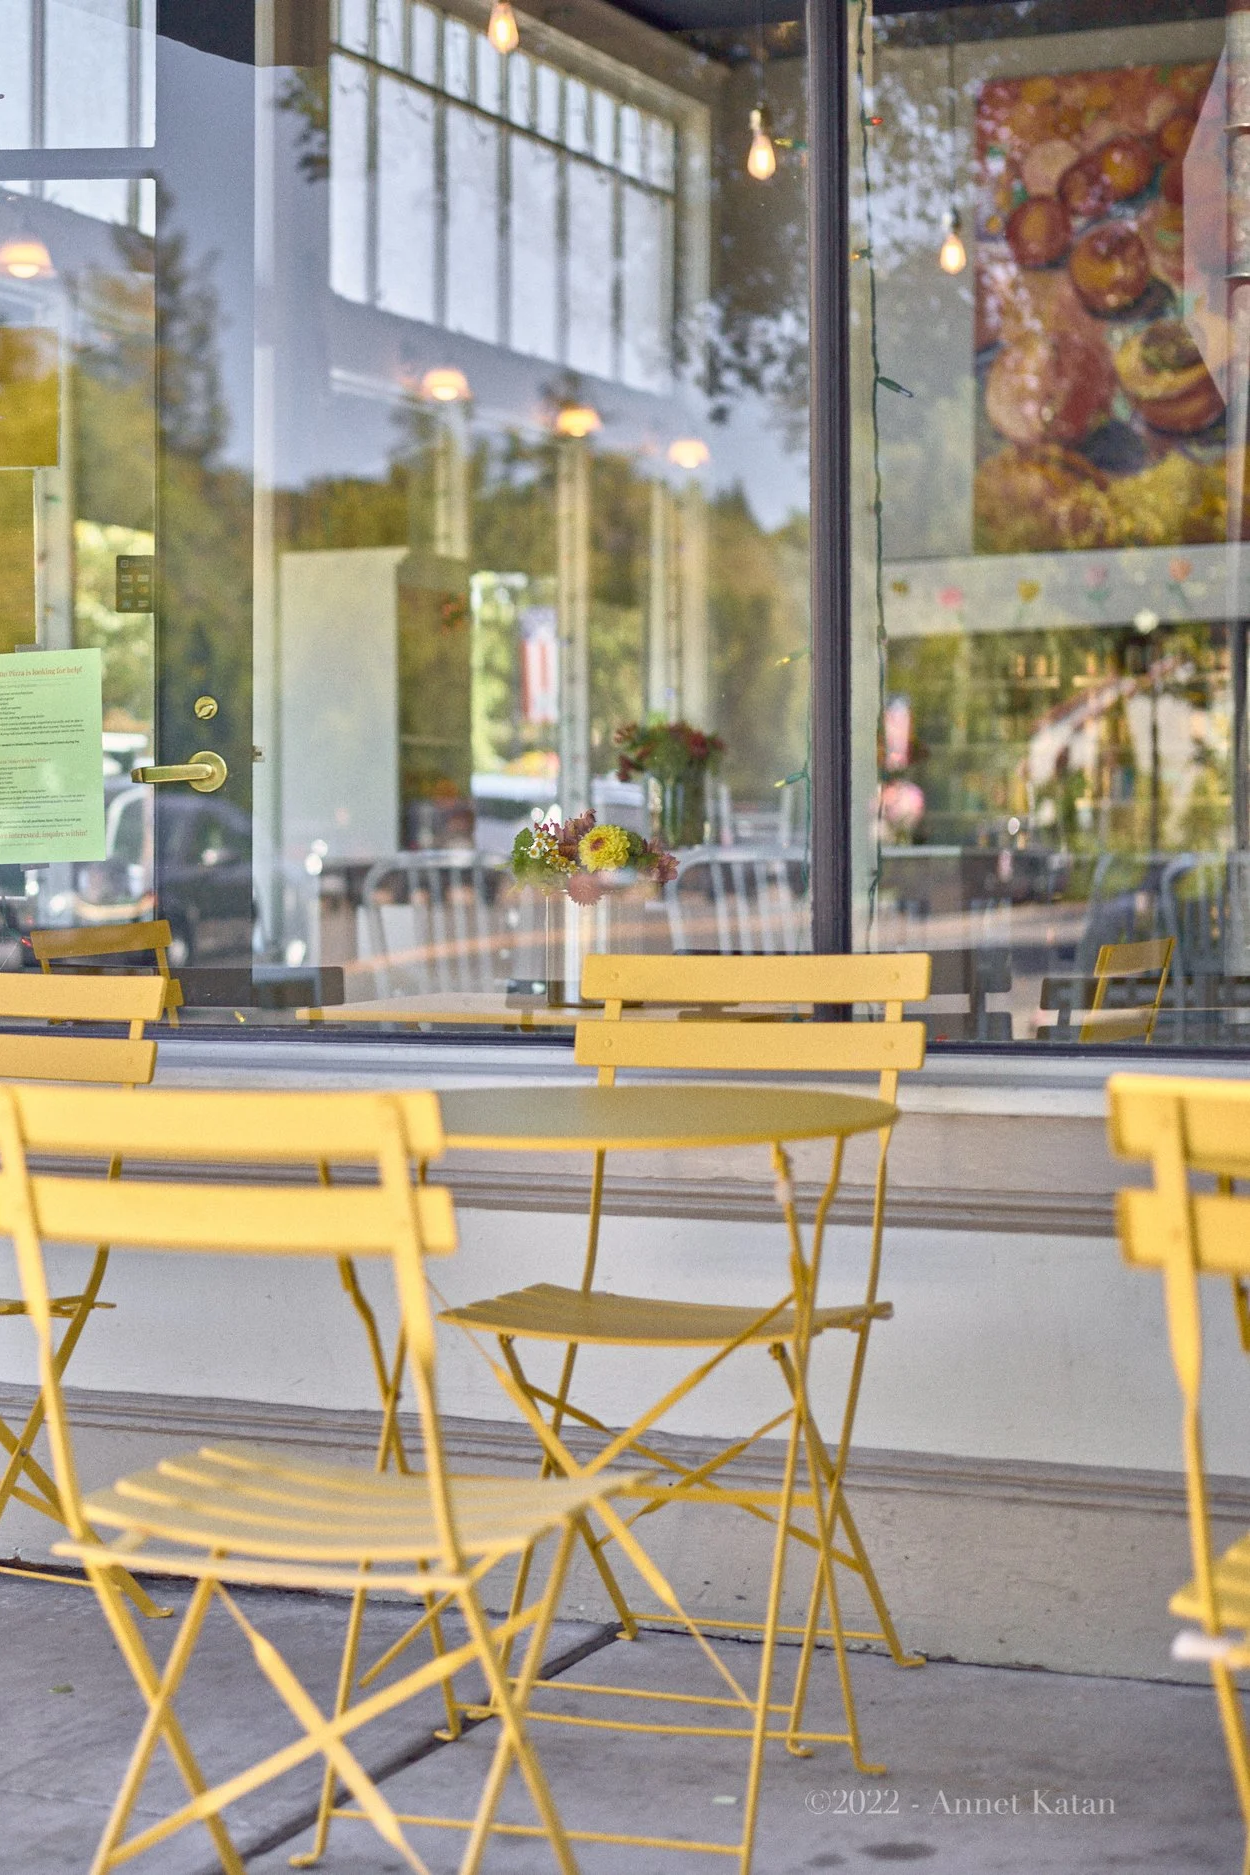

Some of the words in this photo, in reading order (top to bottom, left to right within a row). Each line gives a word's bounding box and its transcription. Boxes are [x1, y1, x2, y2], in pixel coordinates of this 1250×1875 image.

[32, 667, 56, 676] looking
[9, 831, 41, 840] interested,
[65, 829, 88, 838] within!
